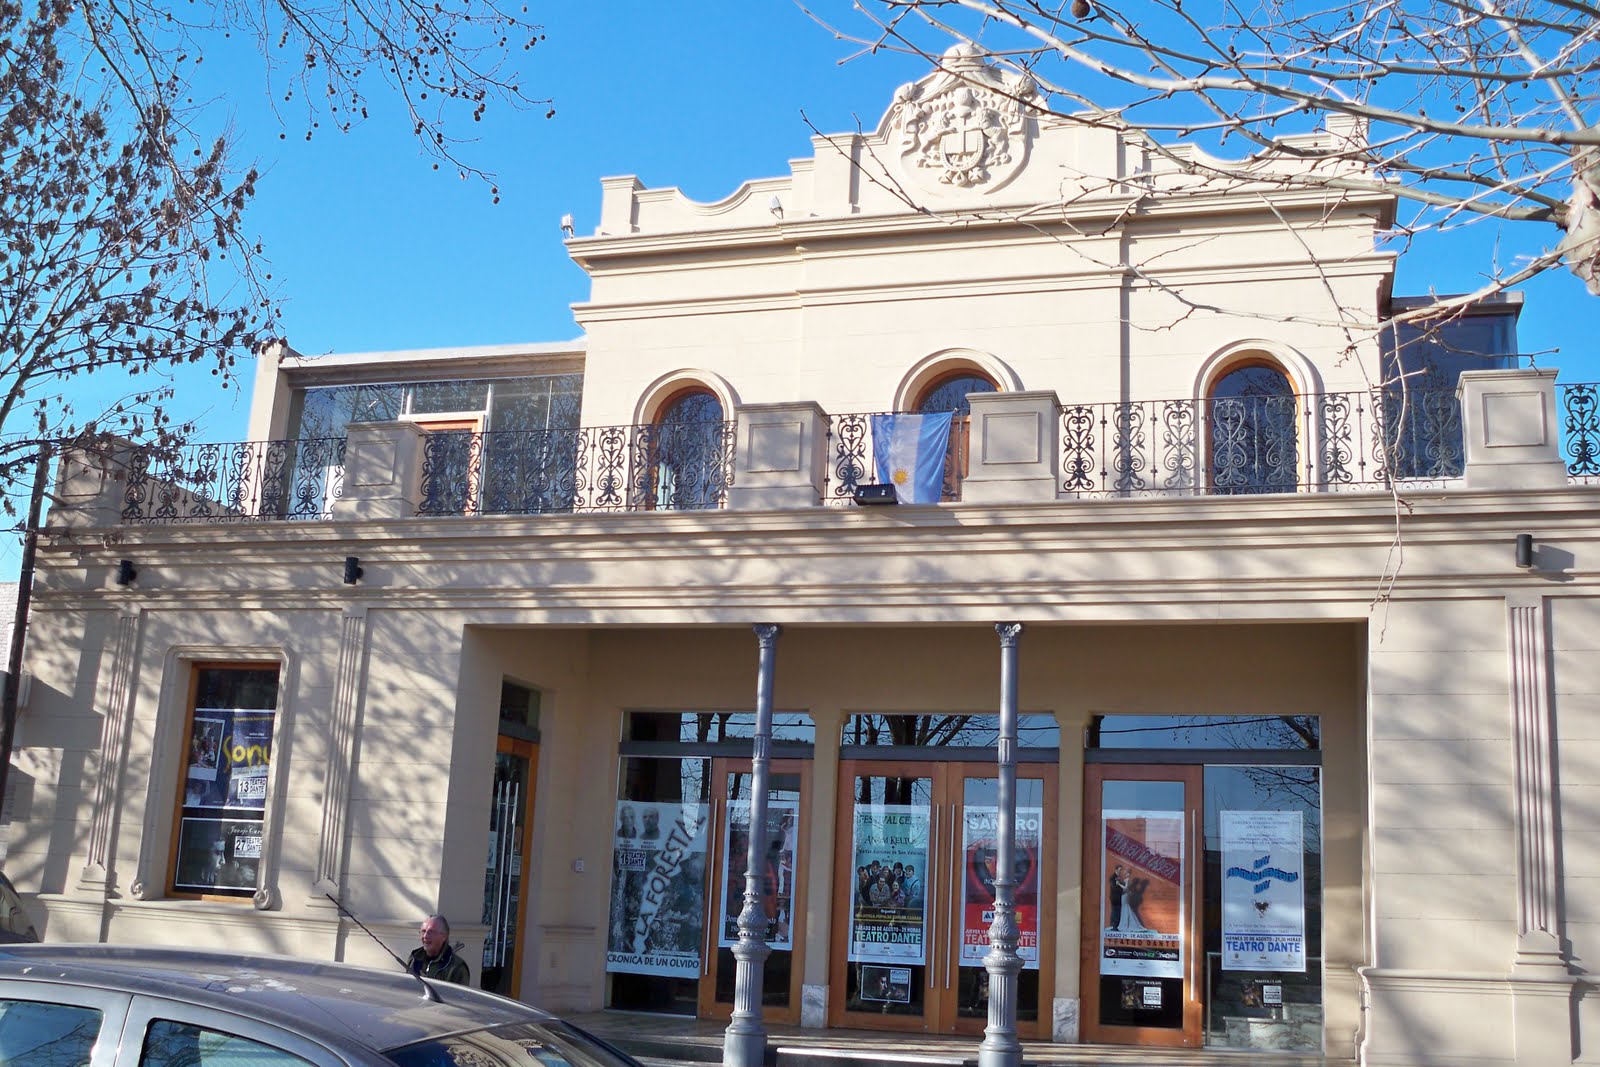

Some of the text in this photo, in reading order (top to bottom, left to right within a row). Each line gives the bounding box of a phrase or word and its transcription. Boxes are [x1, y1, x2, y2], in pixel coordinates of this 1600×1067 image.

[239, 781, 249, 793] 13
[859, 814, 897, 825] FESVAL
[969, 818, 1038, 831] SANRO
[236, 839, 246, 851] 27
[637, 913, 653, 935] LA
[855, 931, 921, 943] TEATRO DANTE
[966, 934, 991, 945] TEAT
[1226, 941, 1300, 953] TEATRO DANTE
[607, 954, 699, 969] CRONICA DE UN OLVIDO
